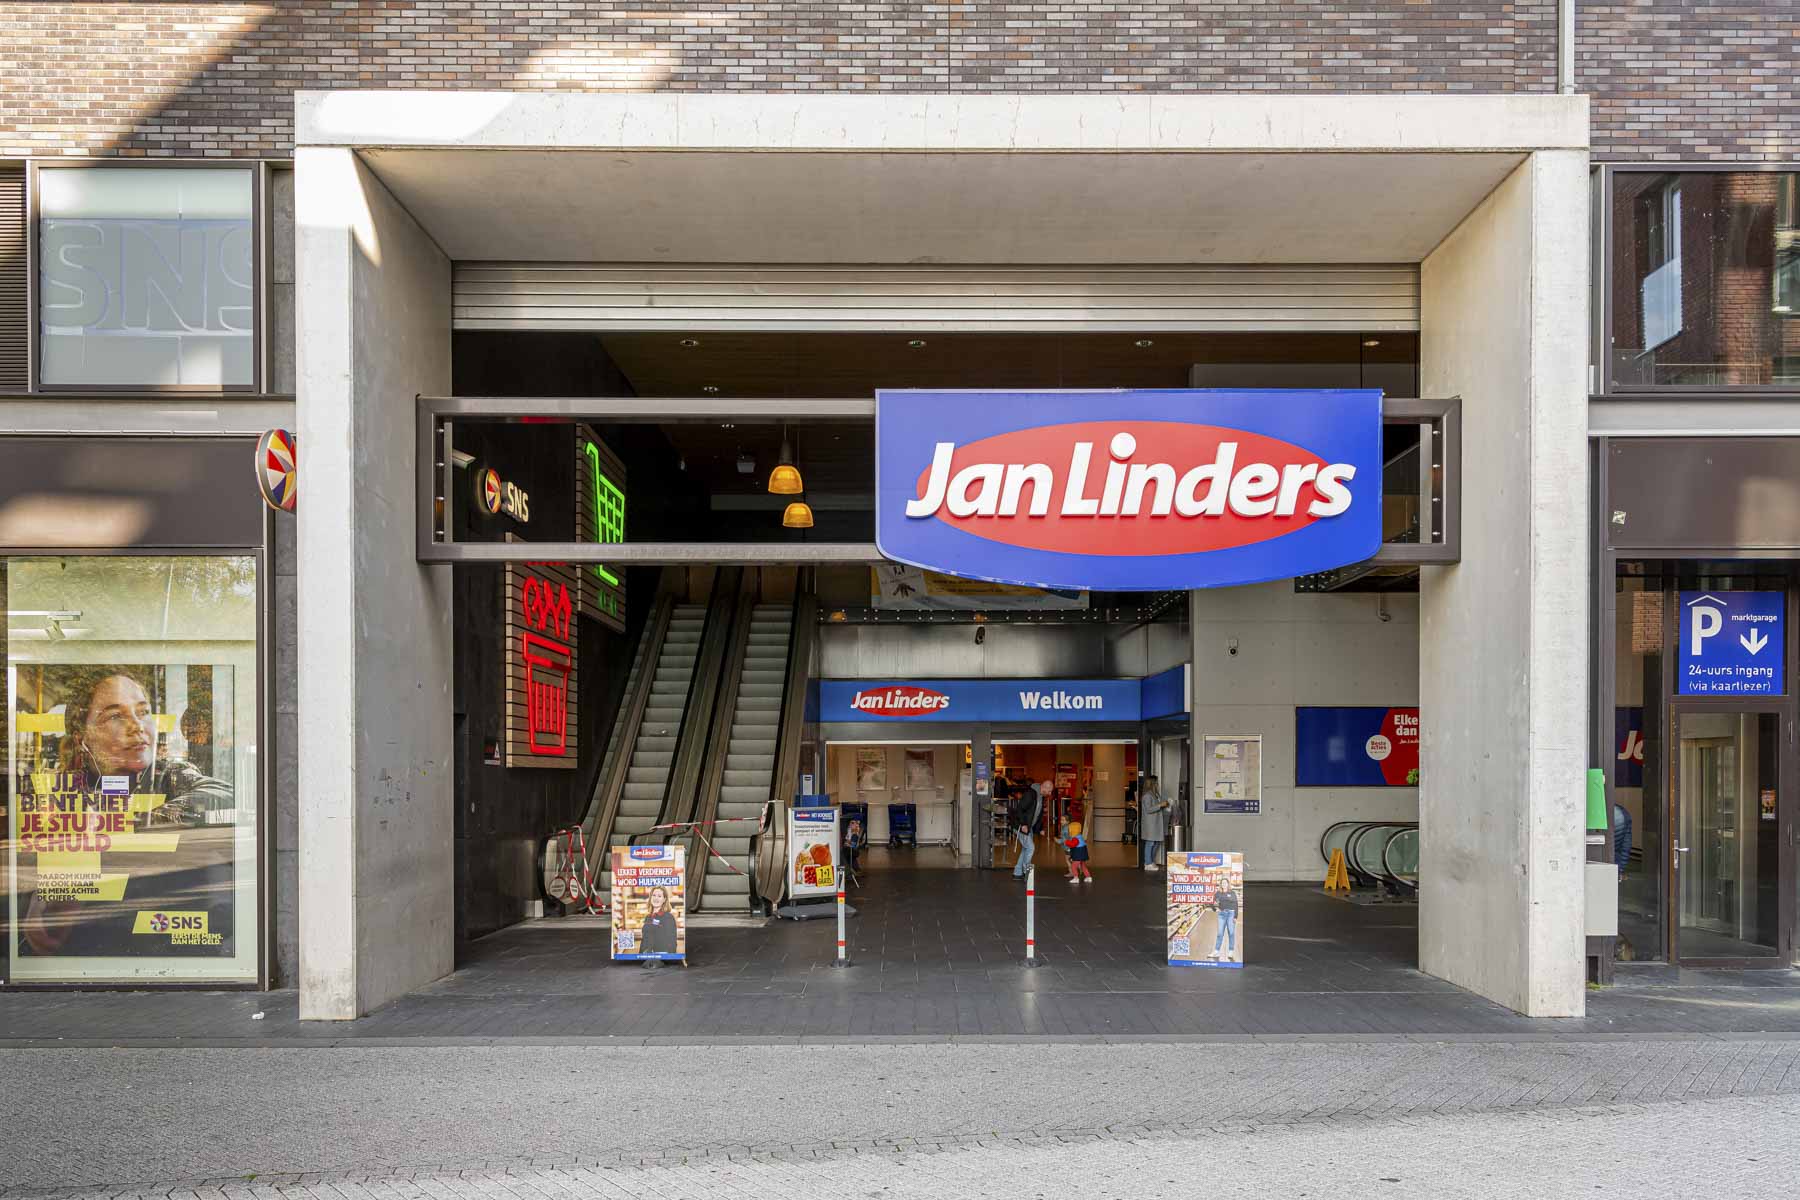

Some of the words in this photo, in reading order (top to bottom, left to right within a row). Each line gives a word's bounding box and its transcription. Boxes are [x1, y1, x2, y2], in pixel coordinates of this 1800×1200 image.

[905, 441, 1054, 518] Jan
[1060, 432, 1357, 518] Linders
[507, 481, 529, 523] SNS
[1731, 613, 1778, 623] marktgarage
[1692, 606, 1723, 656] P
[1689, 664, 1733, 676] 24-uurs
[1735, 664, 1773, 678] ingang
[1689, 681, 1708, 692] (via
[851, 691, 885, 710] Jan
[885, 689, 950, 710] Linders
[1019, 691, 1103, 710] Welkom
[1394, 714, 1418, 725] Elke
[1396, 725, 1417, 736] dan
[20, 793, 78, 812] BENT
[82, 793, 129, 812] NIET
[21, 813, 43, 832] JE
[20, 833, 112, 852] SCHULD
[617, 878, 638, 886] WORD
[1191, 874, 1211, 883] JOUW
[1174, 894, 1186, 903] JAN
[171, 916, 203, 929] SNS
